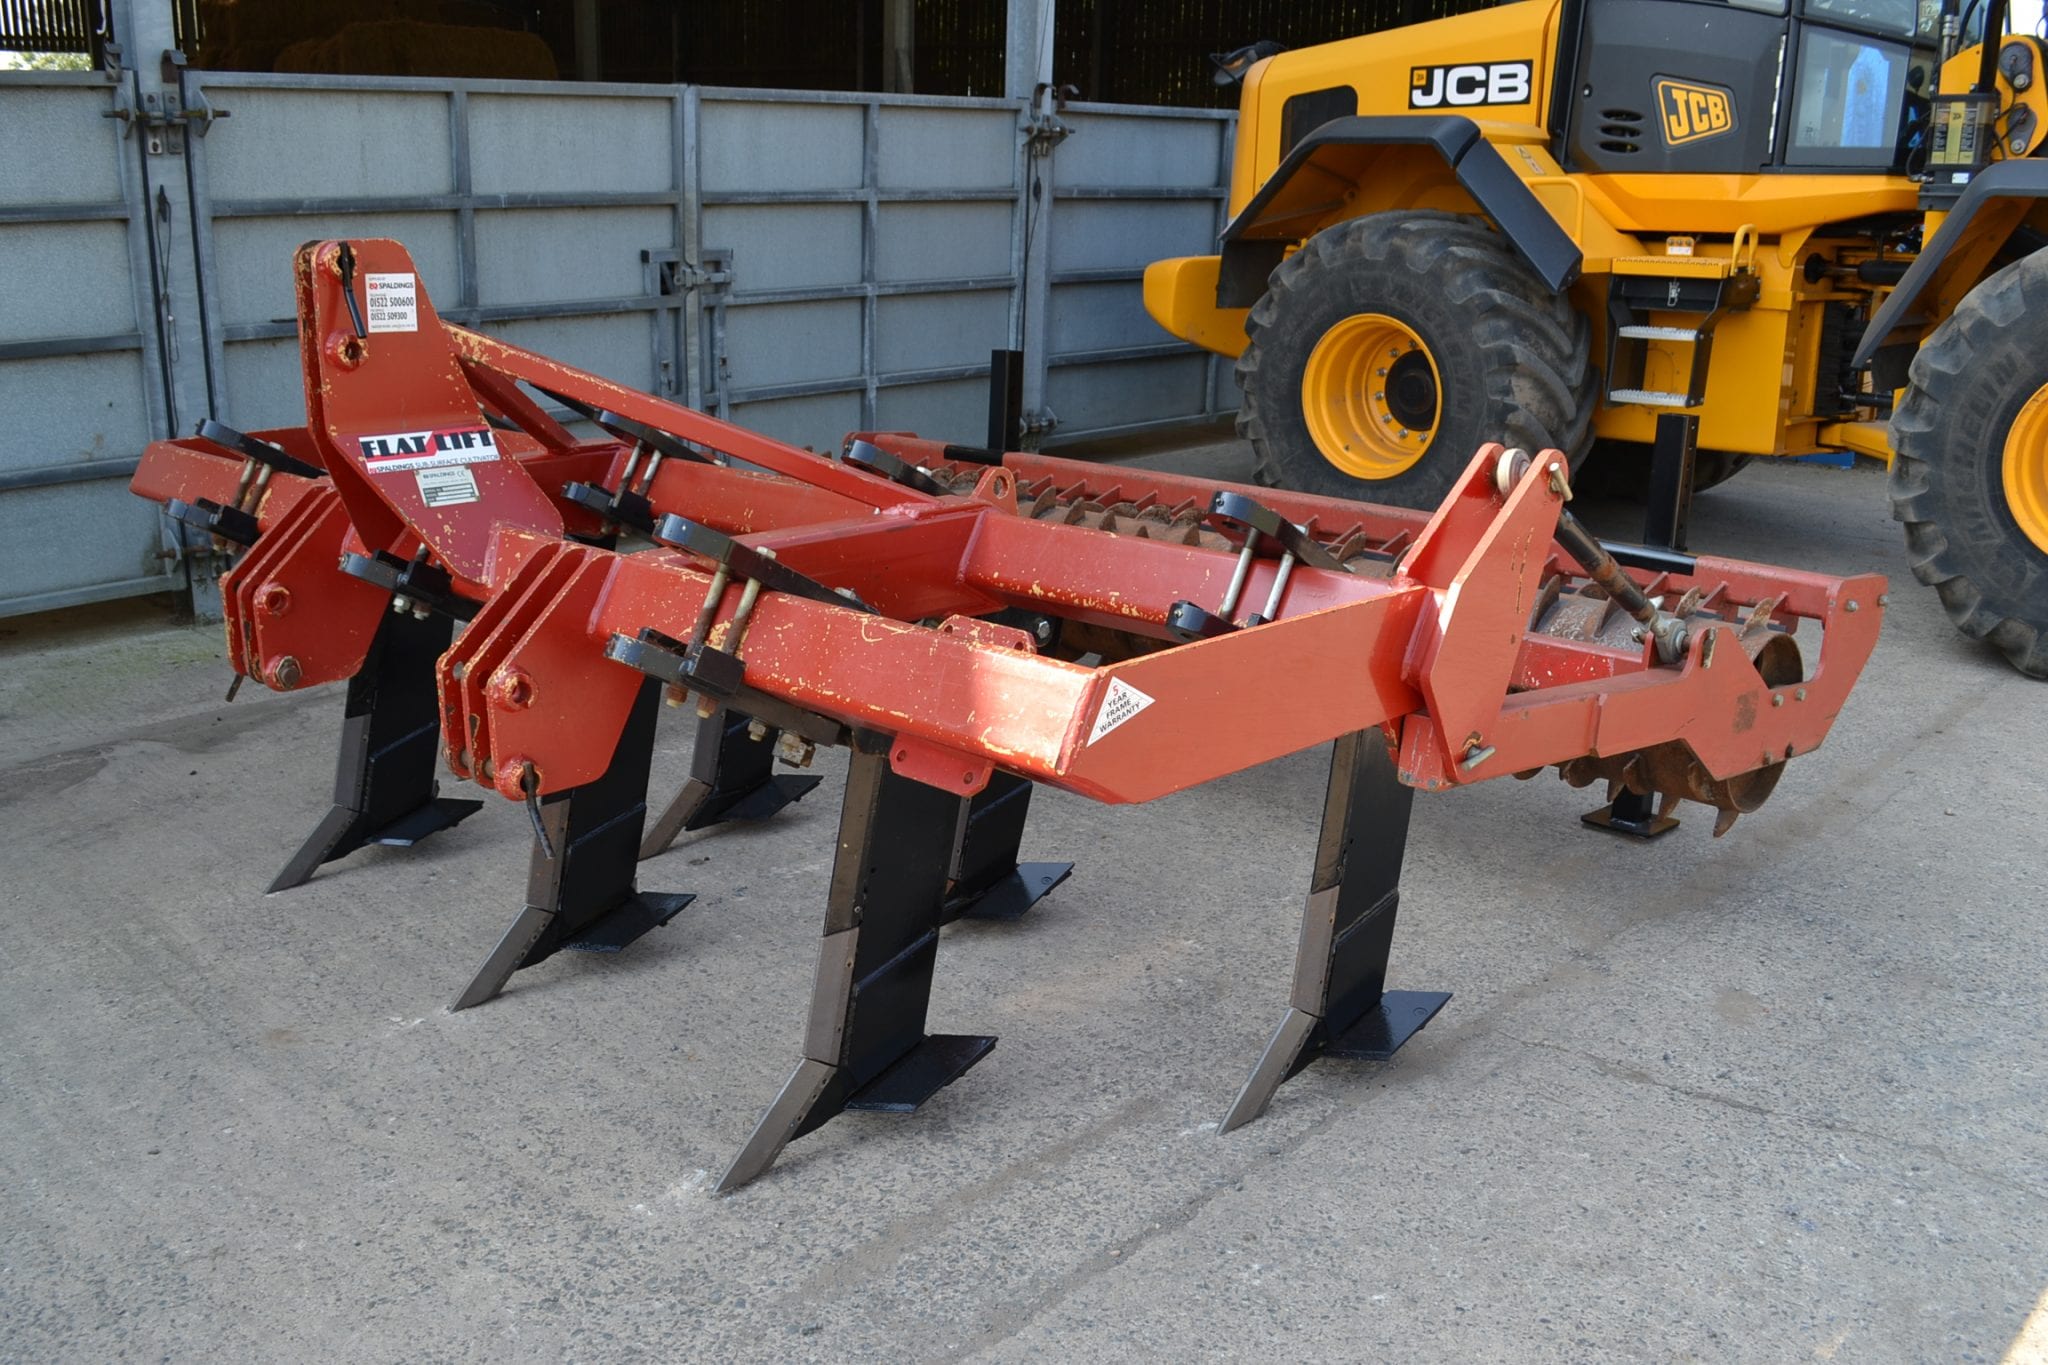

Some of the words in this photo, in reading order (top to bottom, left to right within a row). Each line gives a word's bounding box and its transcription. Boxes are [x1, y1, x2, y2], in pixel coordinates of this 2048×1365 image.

[1412, 64, 1529, 107] JCB
[1669, 87, 1727, 138] JCB
[370, 297, 388, 307] 01522
[390, 296, 414, 307] 500600
[371, 312, 386, 320] 01522
[360, 435, 427, 459] FLAT
[434, 429, 494, 451] LIFT
[376, 463, 414, 473] SPALDINGS
[460, 454, 499, 464] CULTIVATOR
[1108, 692, 1127, 708] YEAR
[1112, 685, 1119, 696] 5
[1100, 702, 1140, 733] WARRANTY
[1106, 699, 1132, 719] FRAME
